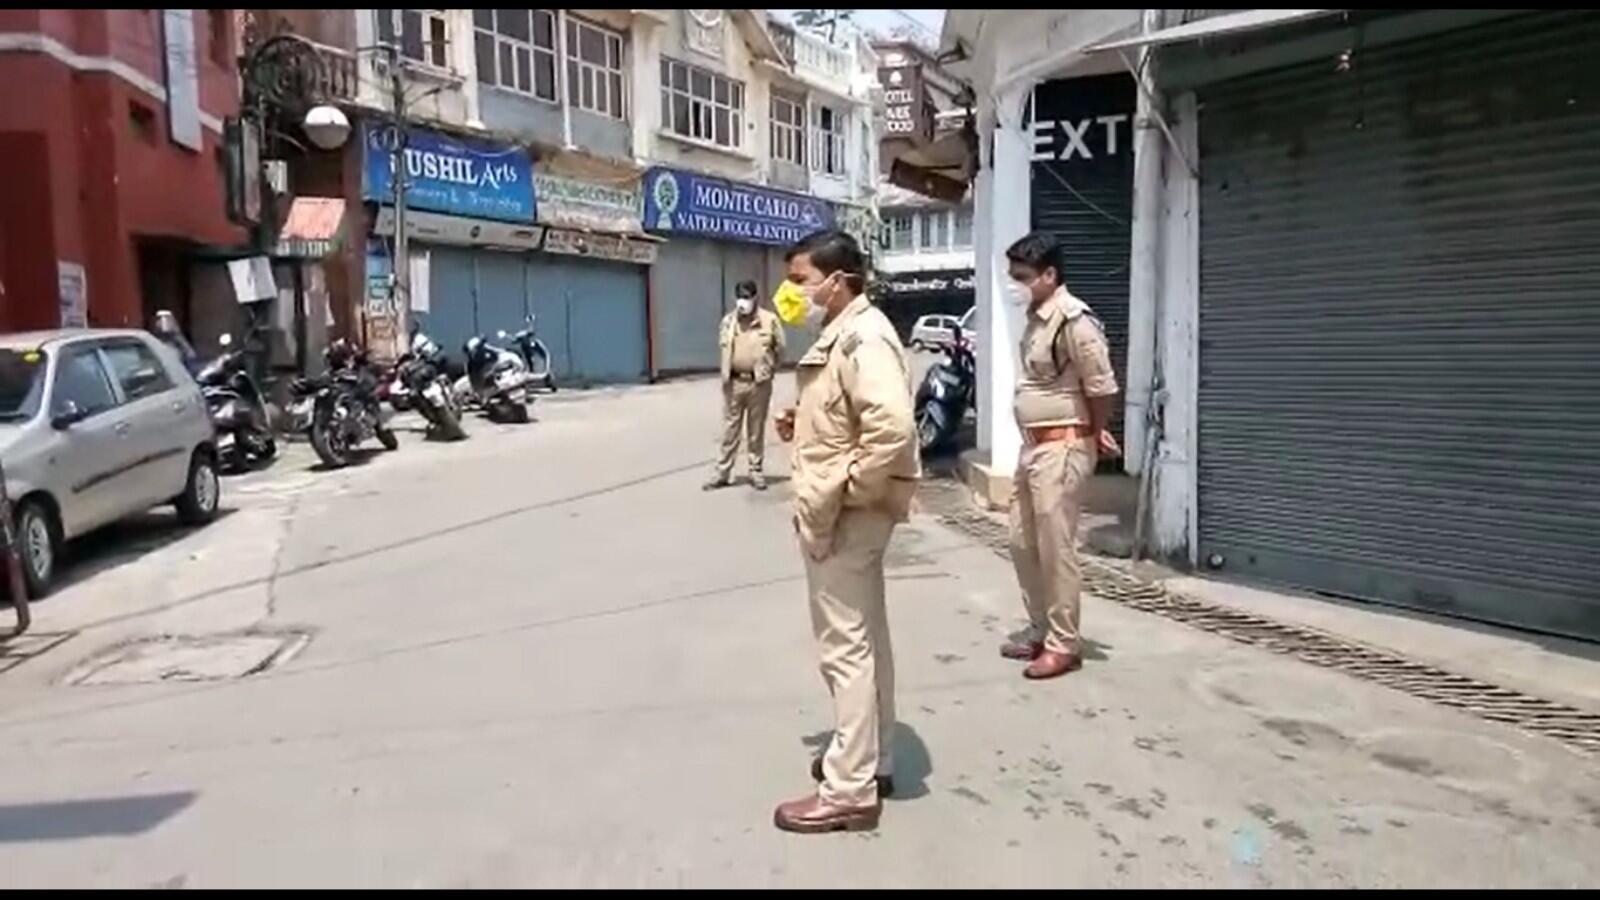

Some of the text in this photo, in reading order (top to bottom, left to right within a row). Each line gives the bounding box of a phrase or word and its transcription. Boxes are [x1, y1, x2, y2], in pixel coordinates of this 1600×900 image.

[884, 90, 914, 103] OTEL
[480, 162, 518, 190] Arts
[696, 185, 799, 220] MONTE CARLO
